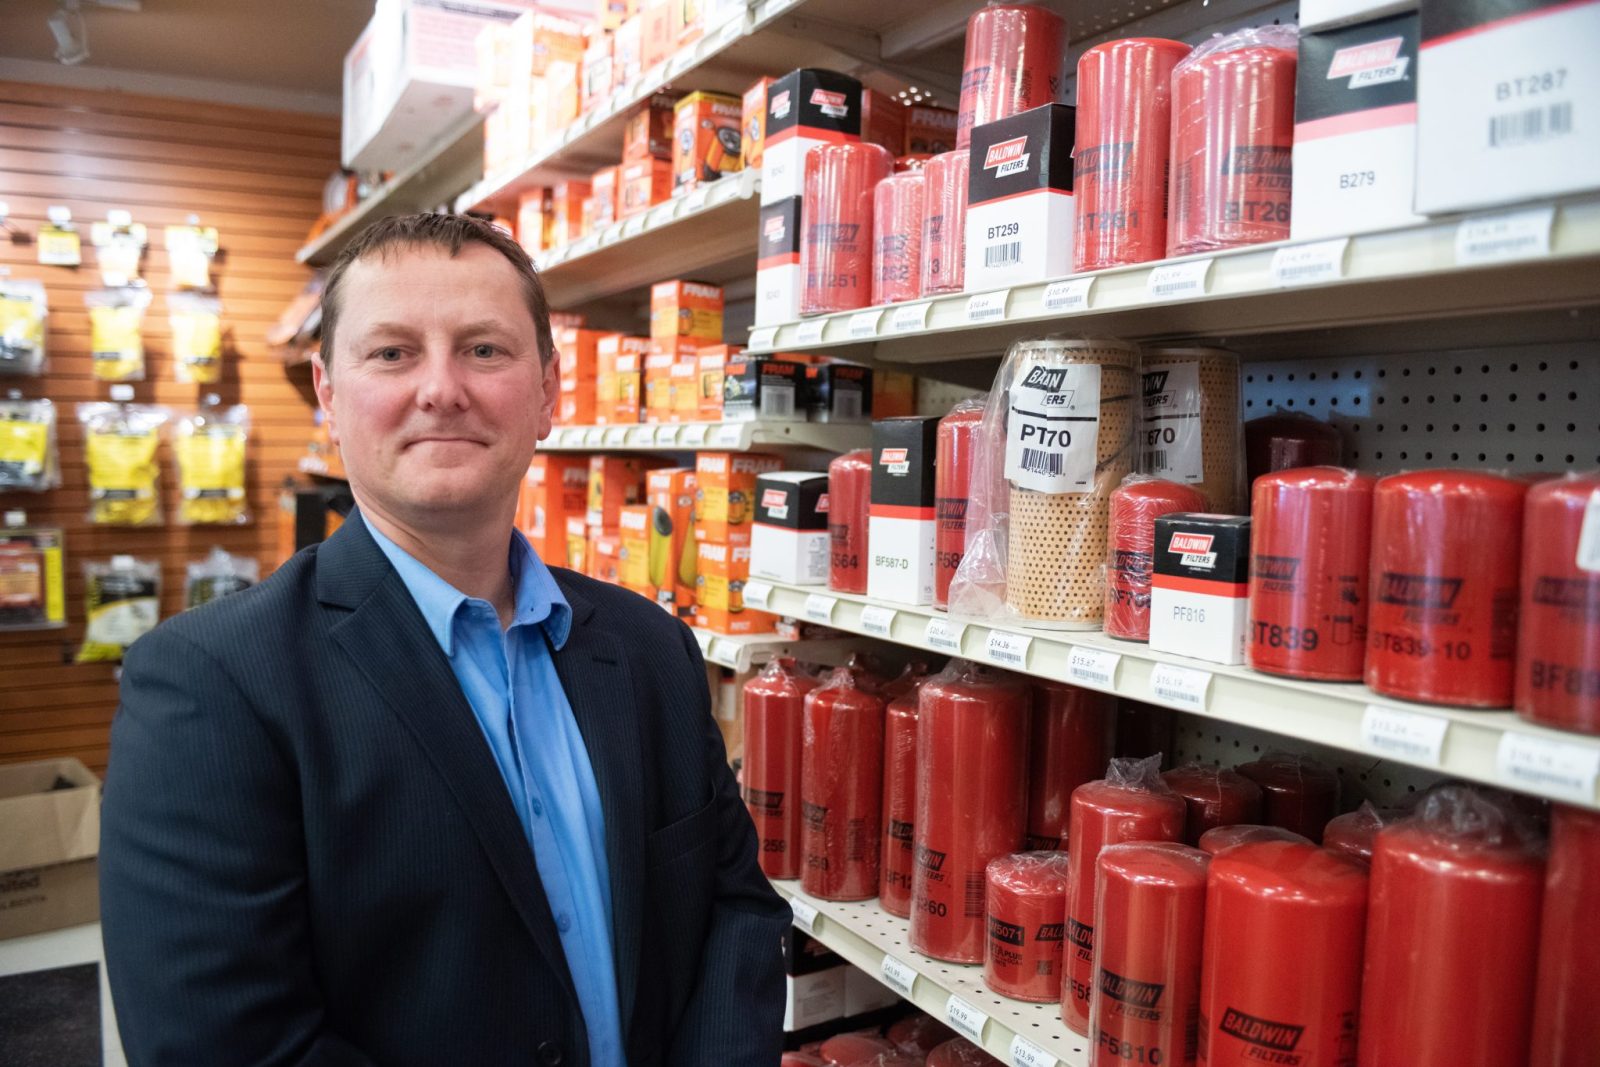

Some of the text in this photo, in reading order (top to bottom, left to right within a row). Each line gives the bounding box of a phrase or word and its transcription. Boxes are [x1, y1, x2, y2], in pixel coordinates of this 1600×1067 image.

[1357, 64, 1398, 82] FILTERS
[1496, 68, 1568, 101] BT287
[990, 143, 1024, 163] BALDWIN
[1000, 159, 1025, 173] FILTERS
[1257, 174, 1292, 189] FILTE
[1339, 170, 1376, 189] B279
[1223, 200, 1290, 223] BT26
[987, 221, 1020, 240] BT259
[1020, 423, 1072, 448] PT70
[731, 458, 782, 475] FRAM
[1172, 536, 1210, 552] BALDWIN
[875, 555, 909, 570] BF587-D
[1186, 554, 1212, 565] FILTERS
[1173, 605, 1206, 623] PF816
[989, 638, 1010, 650] $14.36
[1099, 971, 1157, 1005] BALDWIN
[949, 1004, 969, 1022] $19.99
[1115, 1002, 1161, 1020] FILTERS
[1224, 1011, 1298, 1048] BALDWIN
[1014, 1045, 1036, 1065] $13.99
[1248, 1046, 1302, 1066] FILTERS
